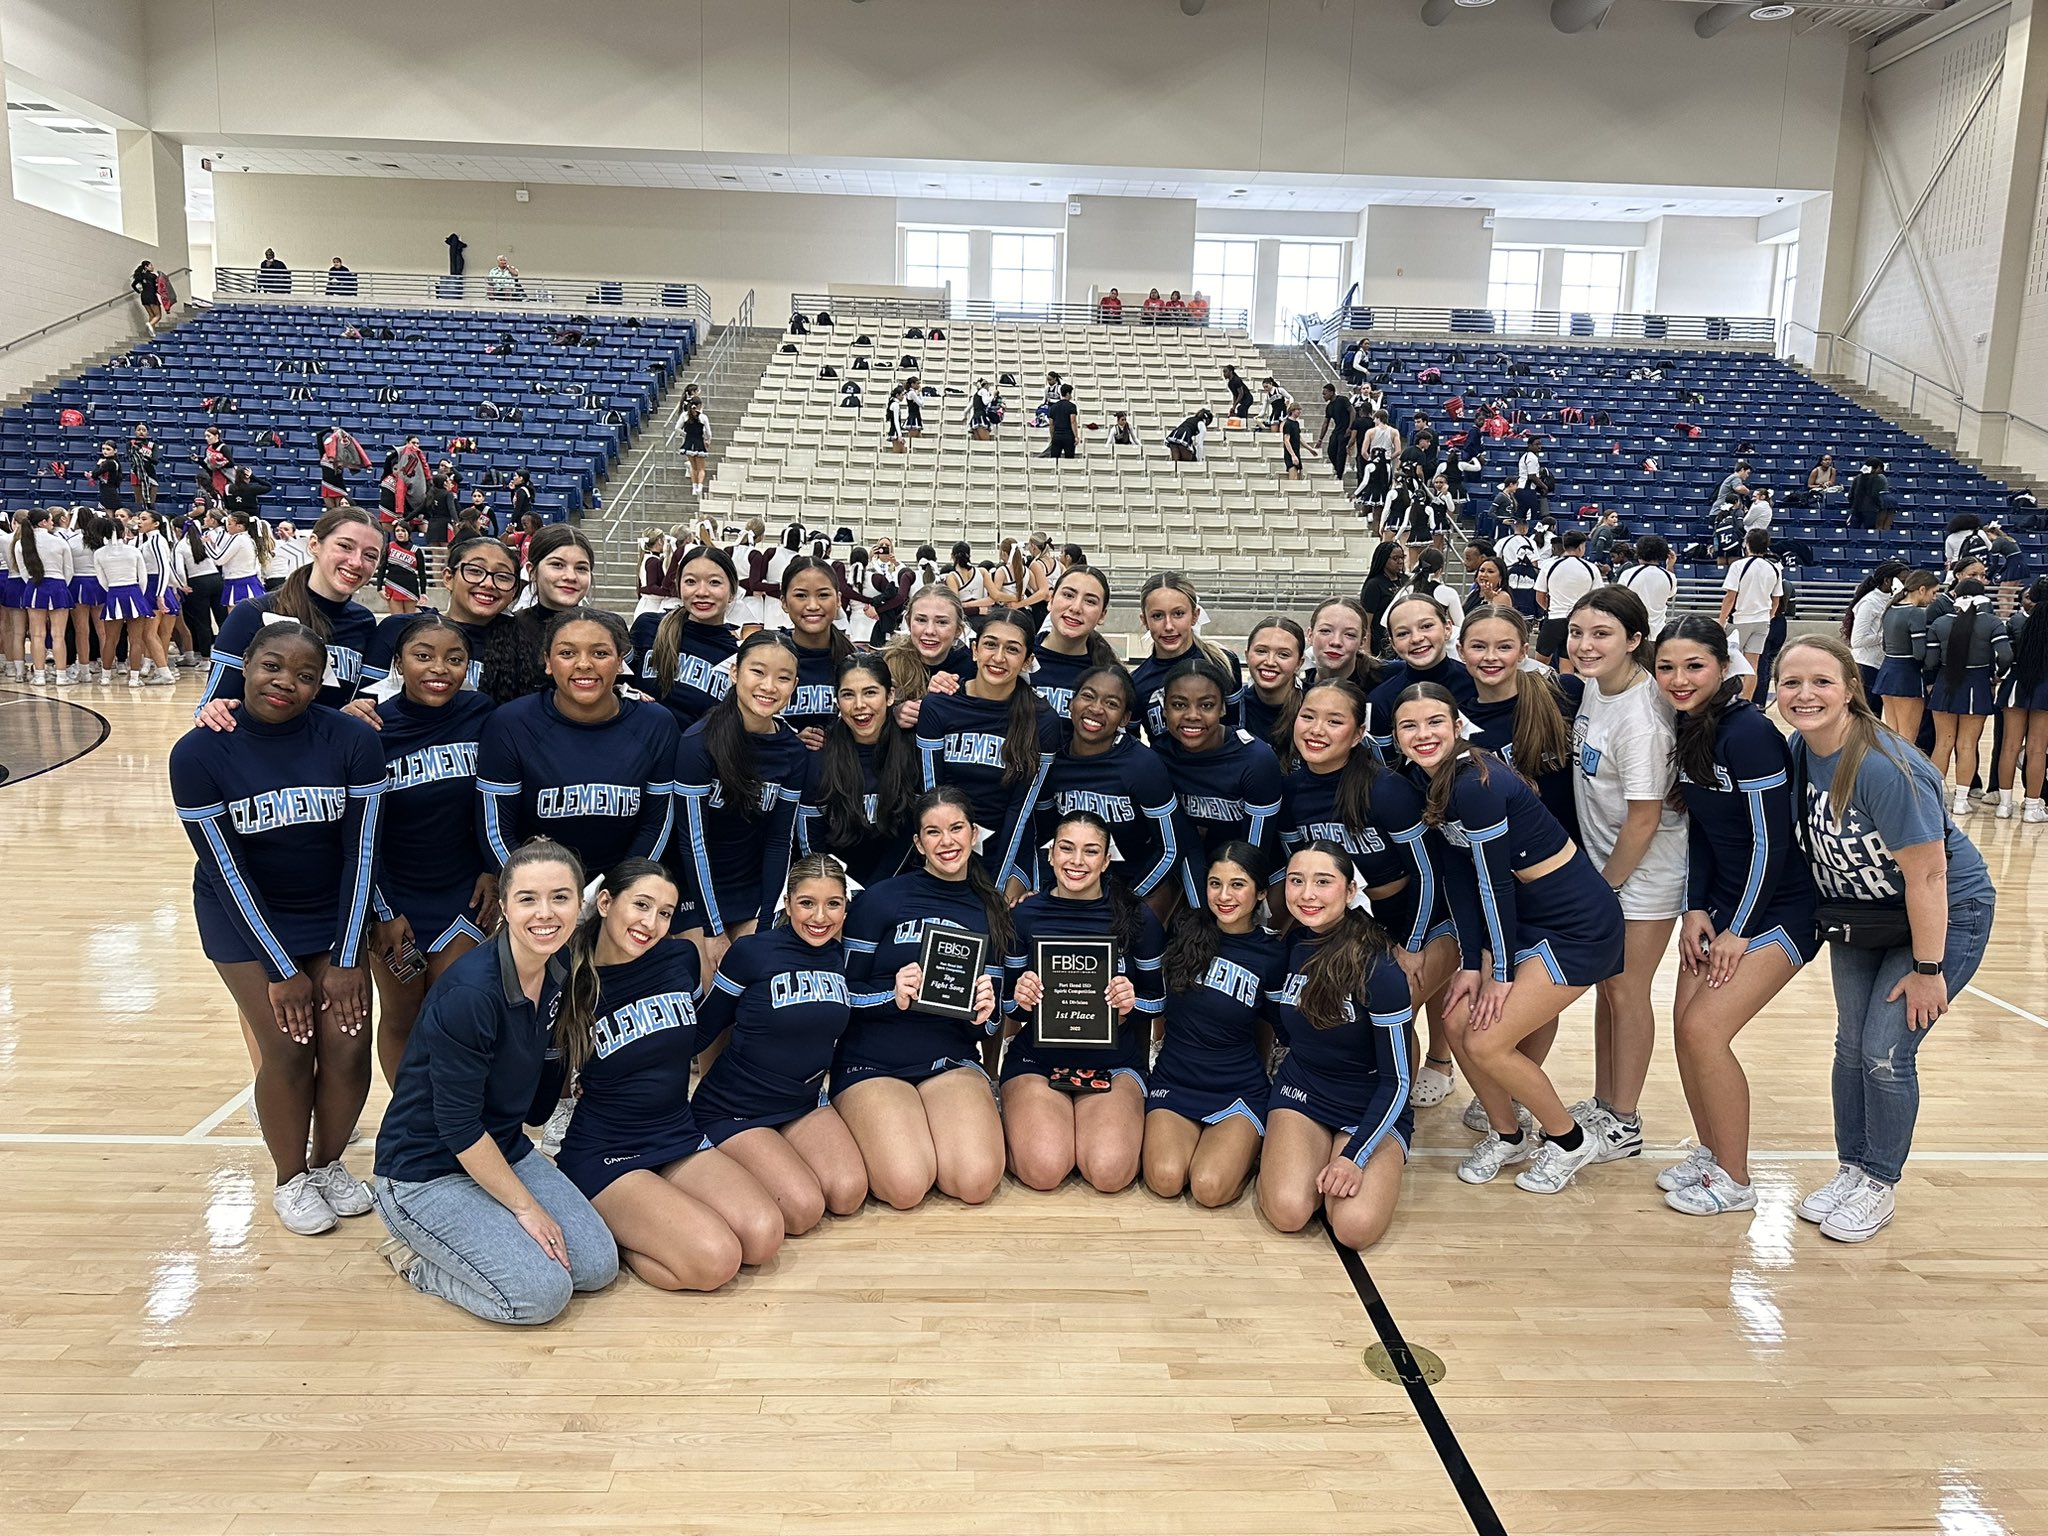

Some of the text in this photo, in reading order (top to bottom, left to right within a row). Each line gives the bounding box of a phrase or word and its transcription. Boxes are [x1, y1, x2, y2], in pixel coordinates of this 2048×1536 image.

[386, 742, 480, 791] CLEMENT
[228, 786, 346, 834] CLEMENTS
[537, 783, 641, 818] CLEMENTS
[1795, 821, 1893, 872] NGER
[1811, 862, 1899, 900] HEER
[770, 970, 851, 1010] CLEMENT
[930, 980, 965, 993] Fight Song
[943, 974, 955, 983] Top
[591, 991, 698, 1060] CLEMENTS
[1055, 1011, 1096, 1020] 1st Place
[1150, 1089, 1170, 1099] MARY
[1280, 1084, 1307, 1104] PALOMA
